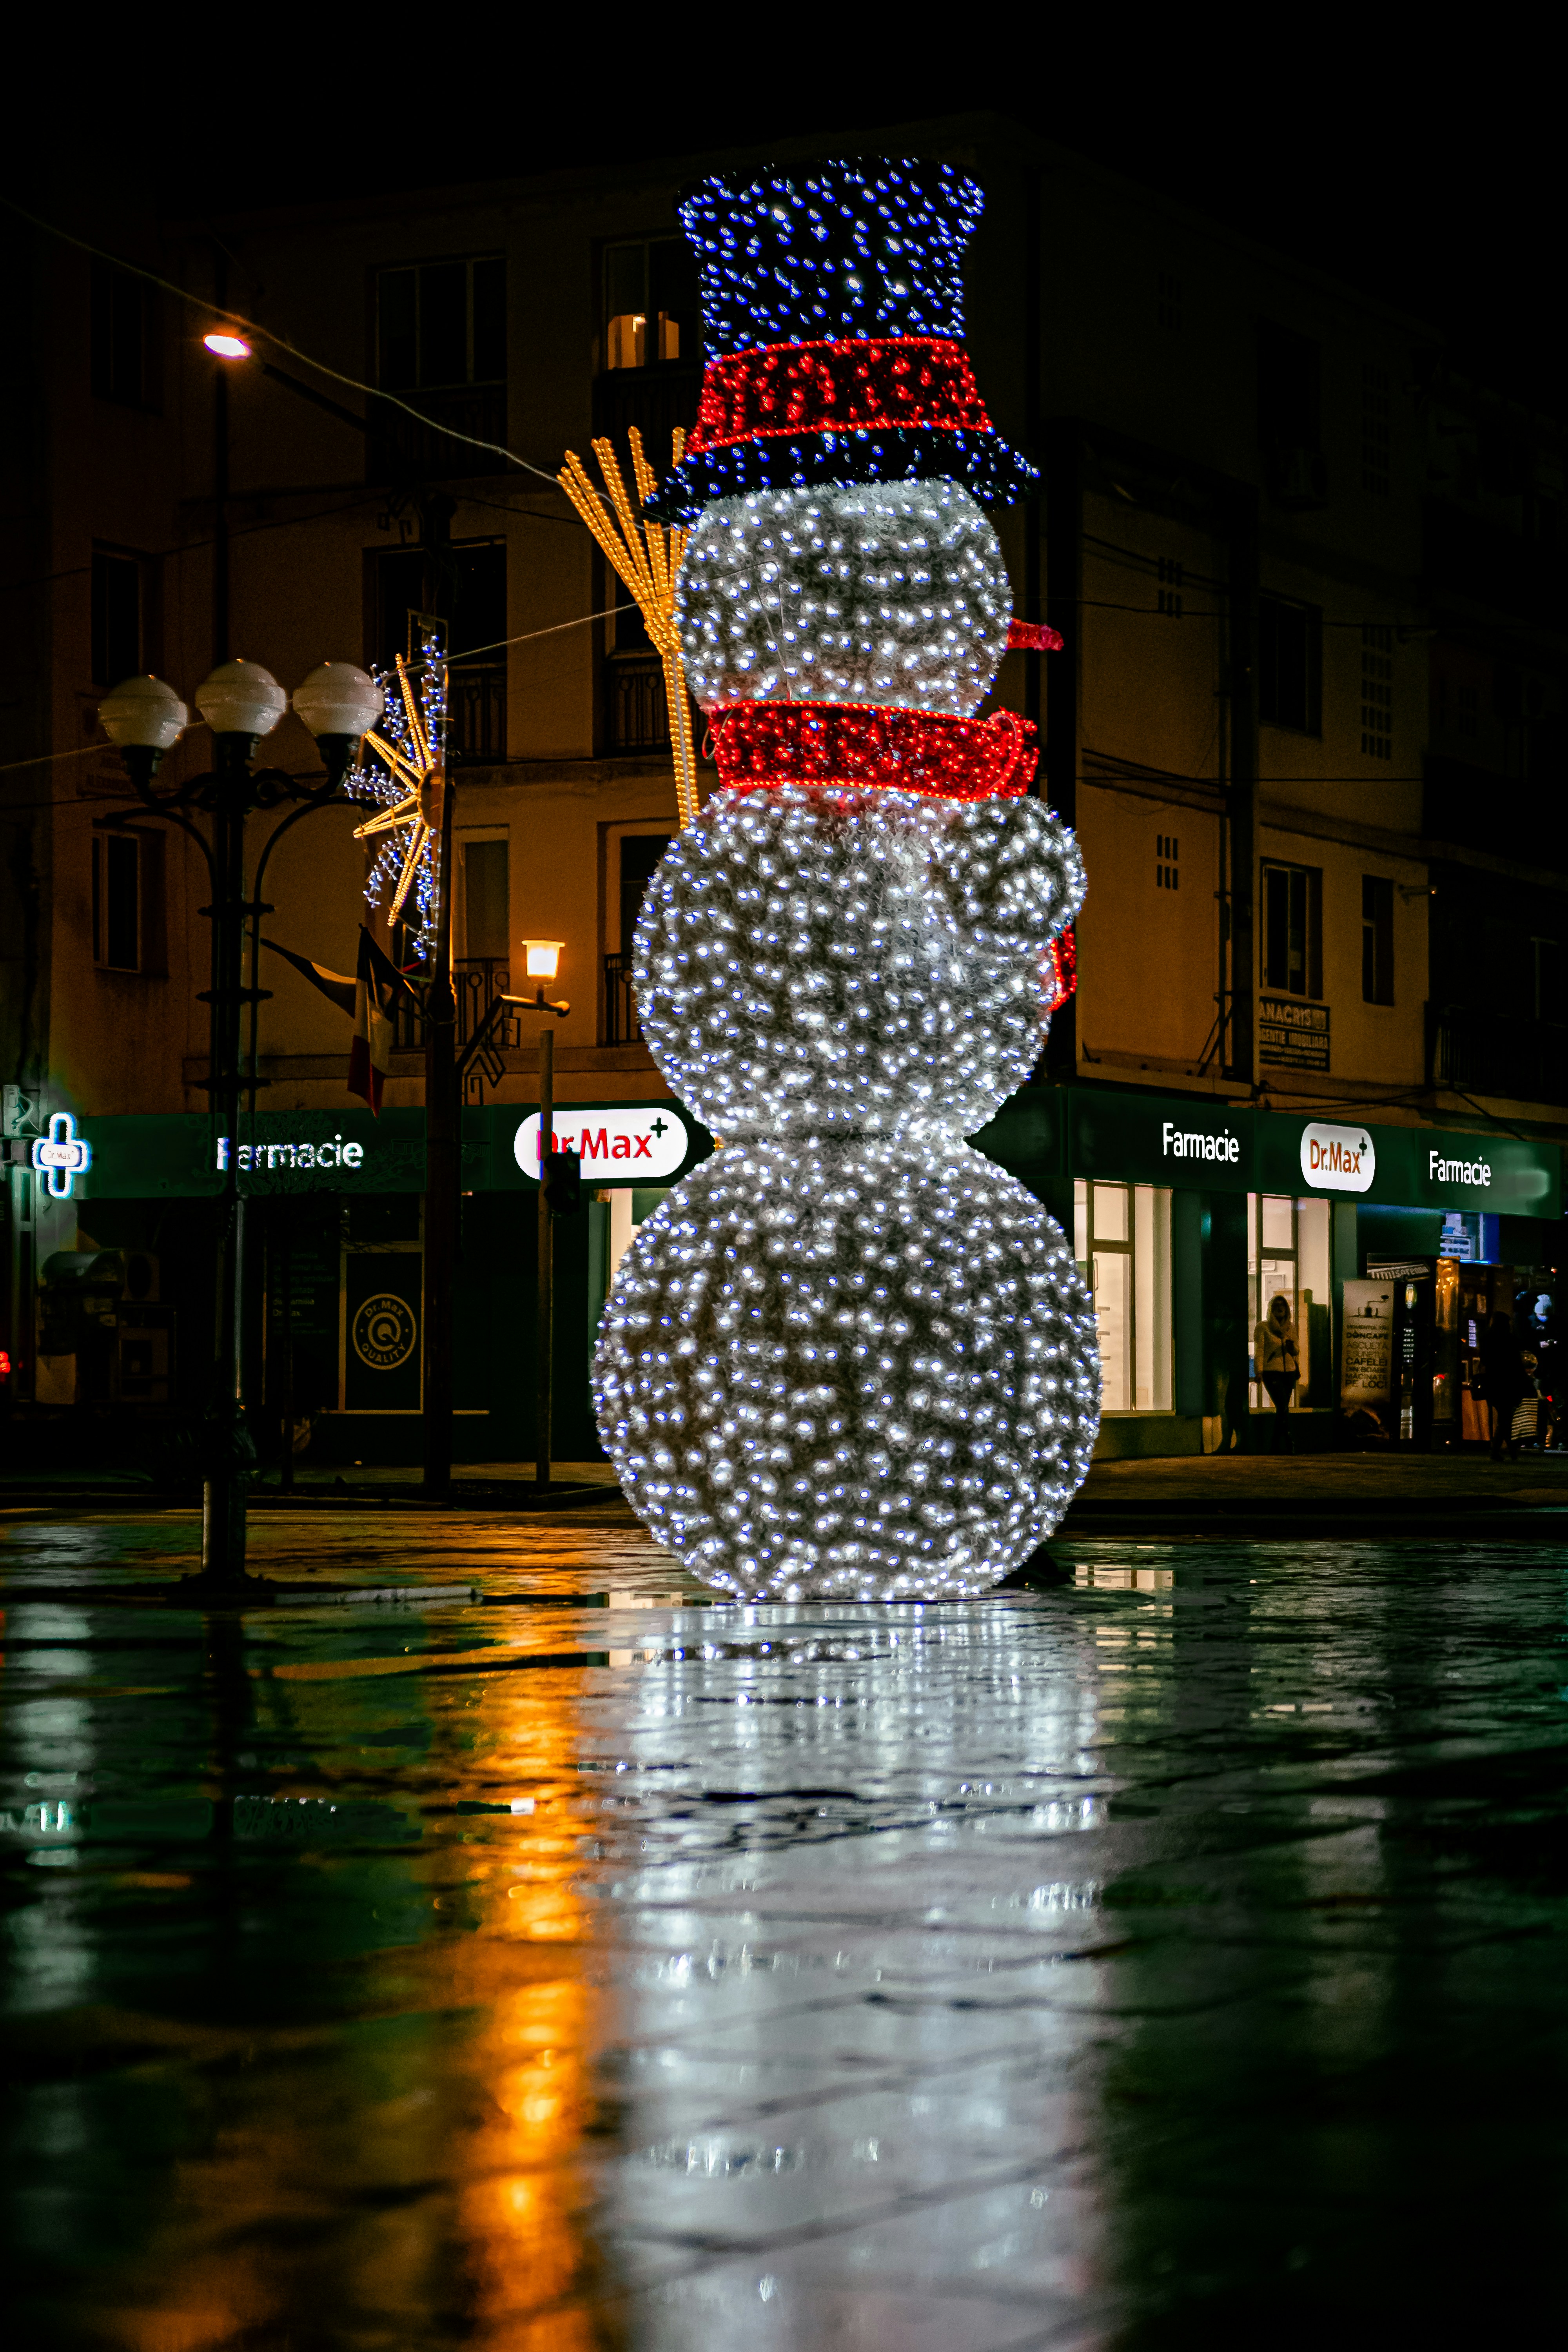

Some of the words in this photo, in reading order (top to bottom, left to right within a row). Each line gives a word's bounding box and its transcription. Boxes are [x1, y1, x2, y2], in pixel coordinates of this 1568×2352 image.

[1259, 1002, 1311, 1027] ANACRIS
[1260, 1028, 1286, 1044] GENTIE
[217, 1134, 363, 1171] Farmacie
[537, 1128, 653, 1161] DrMax
[1163, 1123, 1239, 1162] Farmacie
[1310, 1139, 1361, 1174] Dr.Max
[1430, 1151, 1491, 1186] Farmacie
[364, 1300, 404, 1318] Dr.Max
[361, 1342, 406, 1363] QUALITY
[1346, 1357, 1388, 1366] CAFELEI
